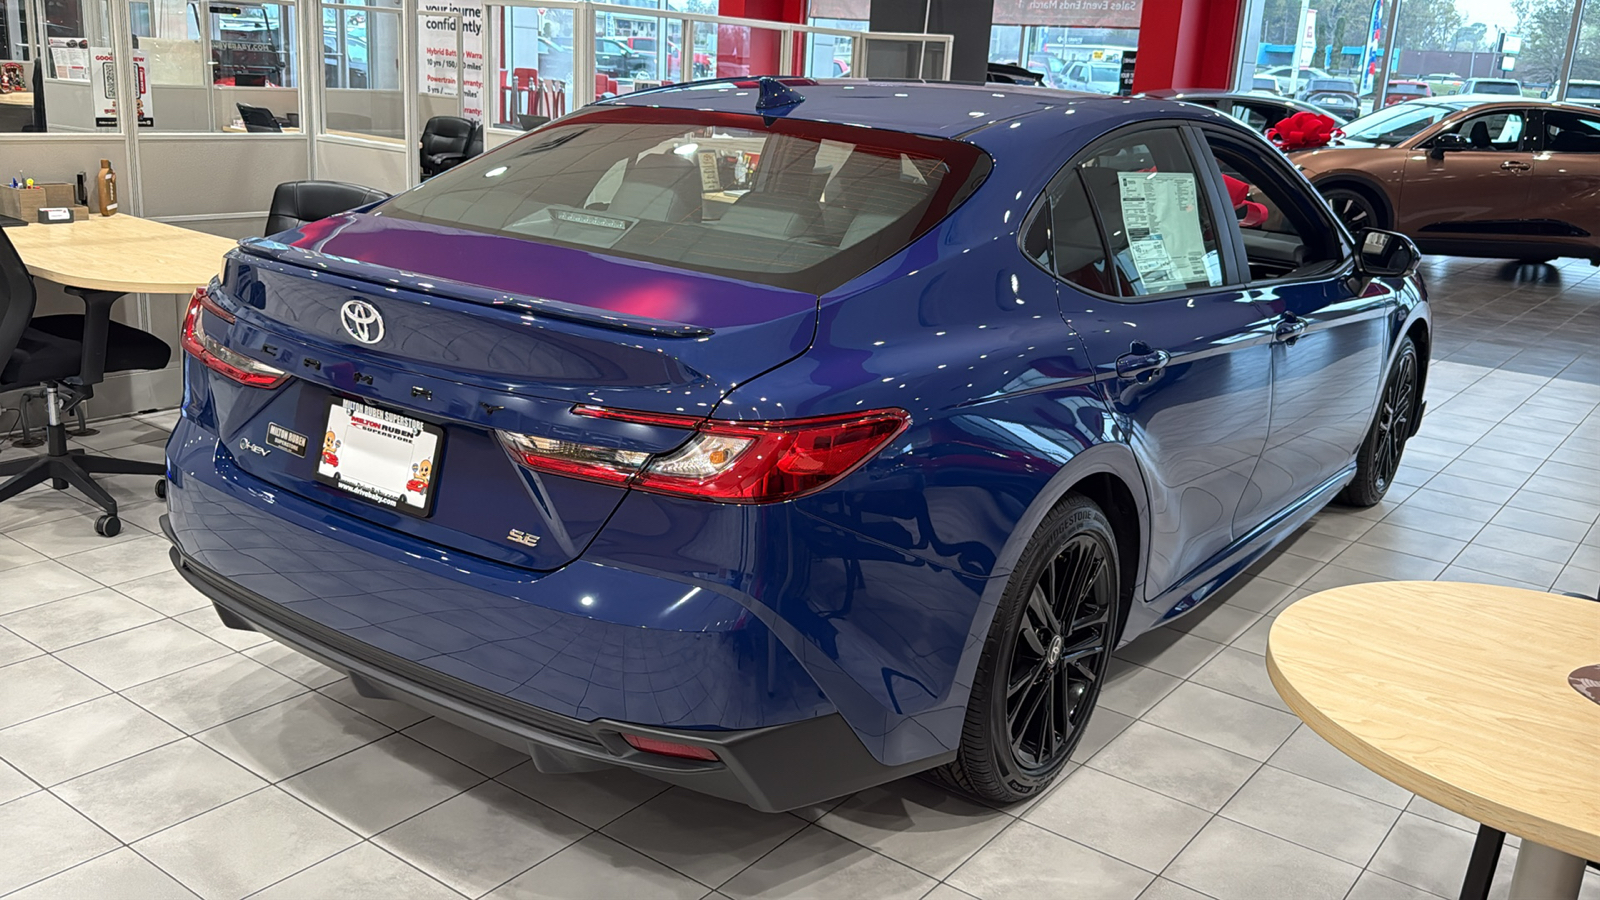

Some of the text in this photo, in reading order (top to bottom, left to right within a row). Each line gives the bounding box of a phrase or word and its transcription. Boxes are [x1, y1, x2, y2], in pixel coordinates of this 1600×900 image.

[449, 3, 482, 20] journe
[426, 17, 482, 36] confidntly
[426, 47, 482, 60] Hybrid Batt Warra
[446, 61, 467, 70] 150,0
[427, 74, 456, 85] Powertrain
[261, 343, 505, 415] CAMRY
[350, 415, 414, 439] MILTON RUBEN
[364, 405, 384, 420] RUBEN
[384, 411, 425, 431] SUPERSTORE
[361, 426, 413, 444] SUPERSTORE
[338, 481, 397, 508] www.drivebaby.com
[507, 528, 541, 547] SE
